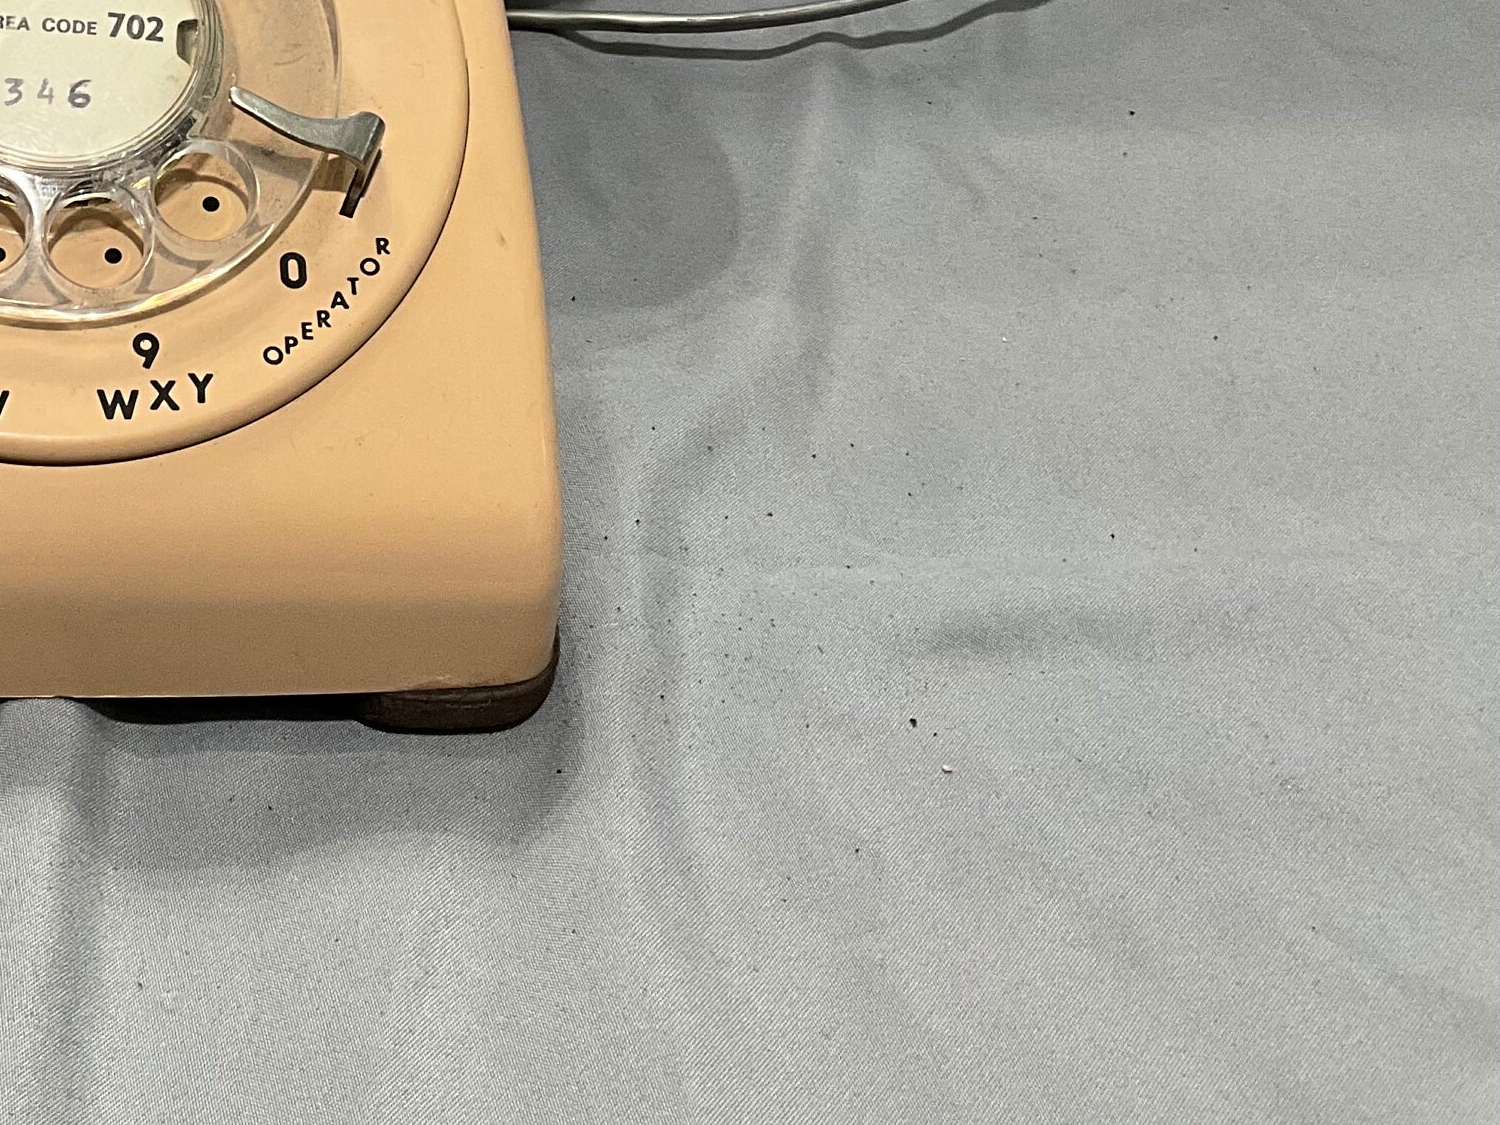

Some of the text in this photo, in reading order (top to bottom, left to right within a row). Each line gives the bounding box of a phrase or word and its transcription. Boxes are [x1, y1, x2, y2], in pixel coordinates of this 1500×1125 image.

[41, 17, 97, 35] CODE
[107, 12, 164, 43] 702
[279, 251, 308, 290] 0
[262, 237, 391, 365] OPERATOR
[132, 332, 160, 369] 9
[97, 372, 214, 420] WXY
